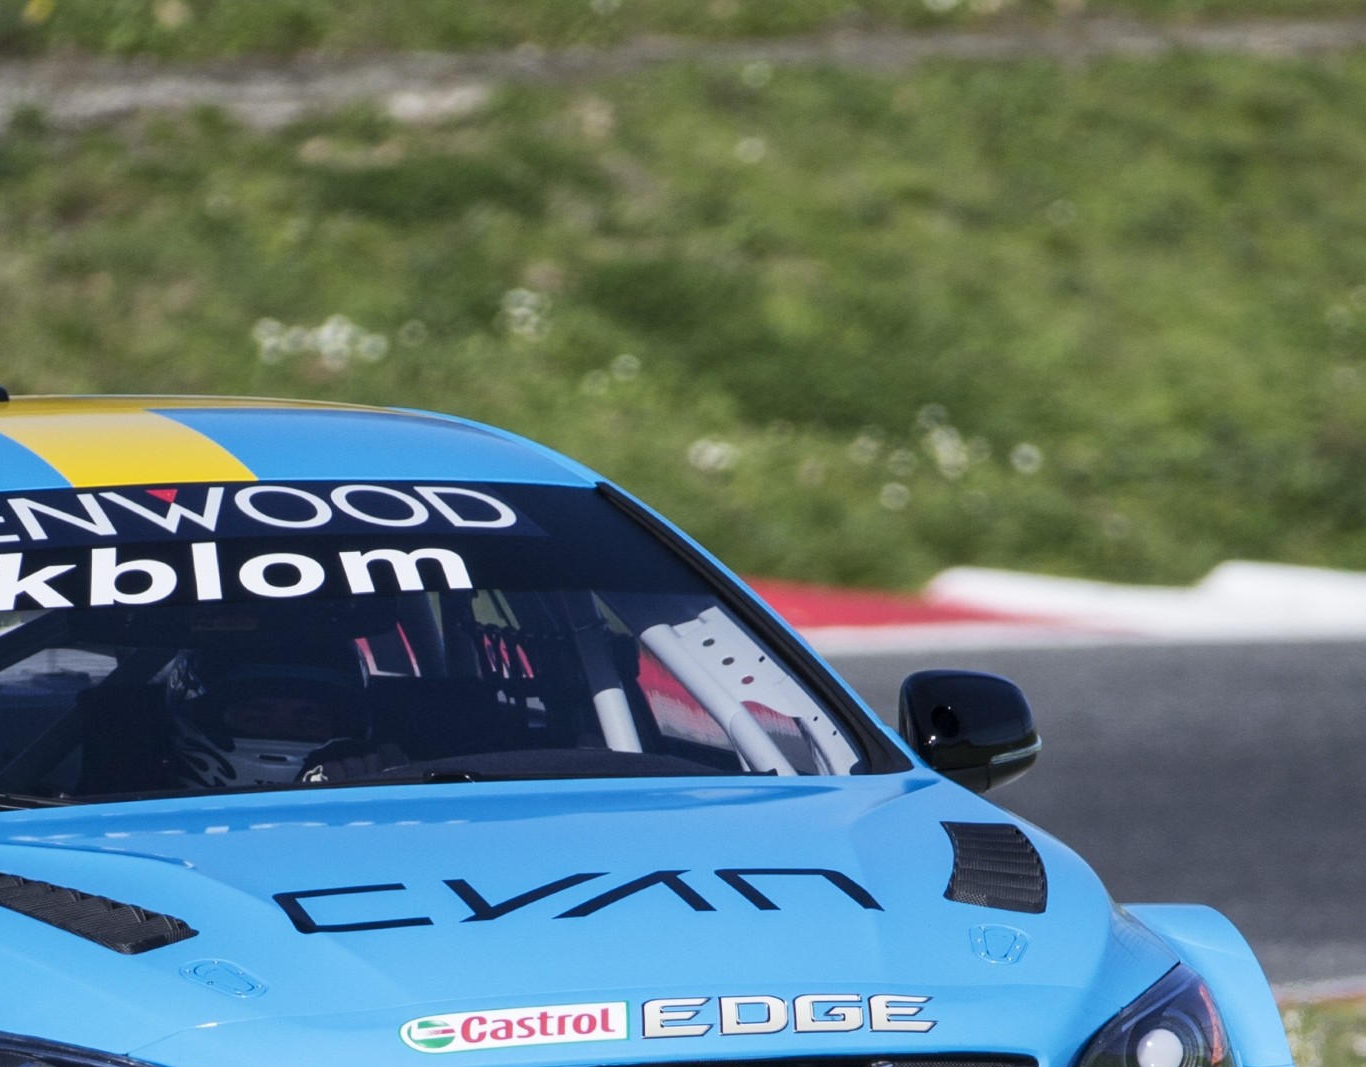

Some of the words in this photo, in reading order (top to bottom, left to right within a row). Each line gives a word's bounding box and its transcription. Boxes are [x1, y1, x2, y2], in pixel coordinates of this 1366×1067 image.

[272, 867, 886, 935] CYAN
[460, 1007, 616, 1044] Castrol
[640, 993, 939, 1040] EDGE
